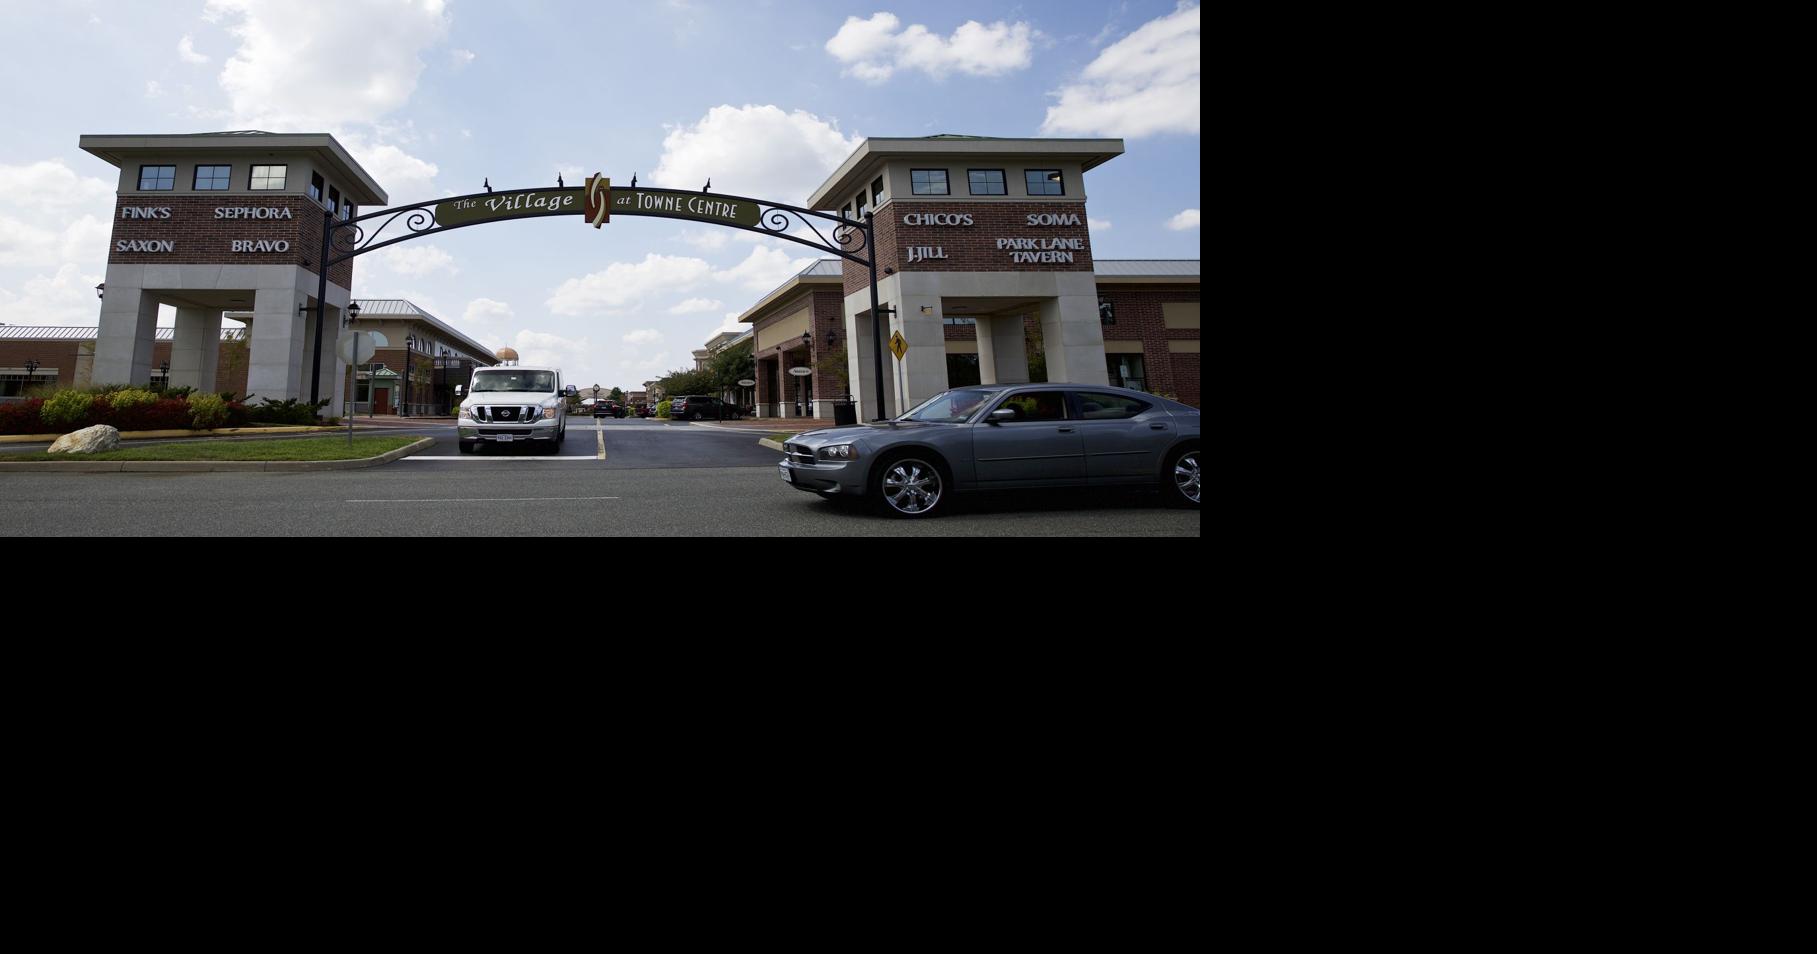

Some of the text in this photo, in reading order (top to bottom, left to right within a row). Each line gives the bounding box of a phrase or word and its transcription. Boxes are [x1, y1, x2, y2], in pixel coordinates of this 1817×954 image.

[453, 192, 738, 219] The Village at TOWNE CENTRE
[121, 207, 172, 219] FINK'S
[214, 206, 292, 219] SEPHORA
[903, 213, 974, 226] CHICO'S
[1026, 213, 1082, 226] SOMA
[116, 239, 175, 252] SAXON
[231, 240, 290, 253] BRAVO
[996, 237, 1085, 250] PARK LANE
[906, 246, 949, 263] J.JILL
[1009, 251, 1074, 263] TAVERN
